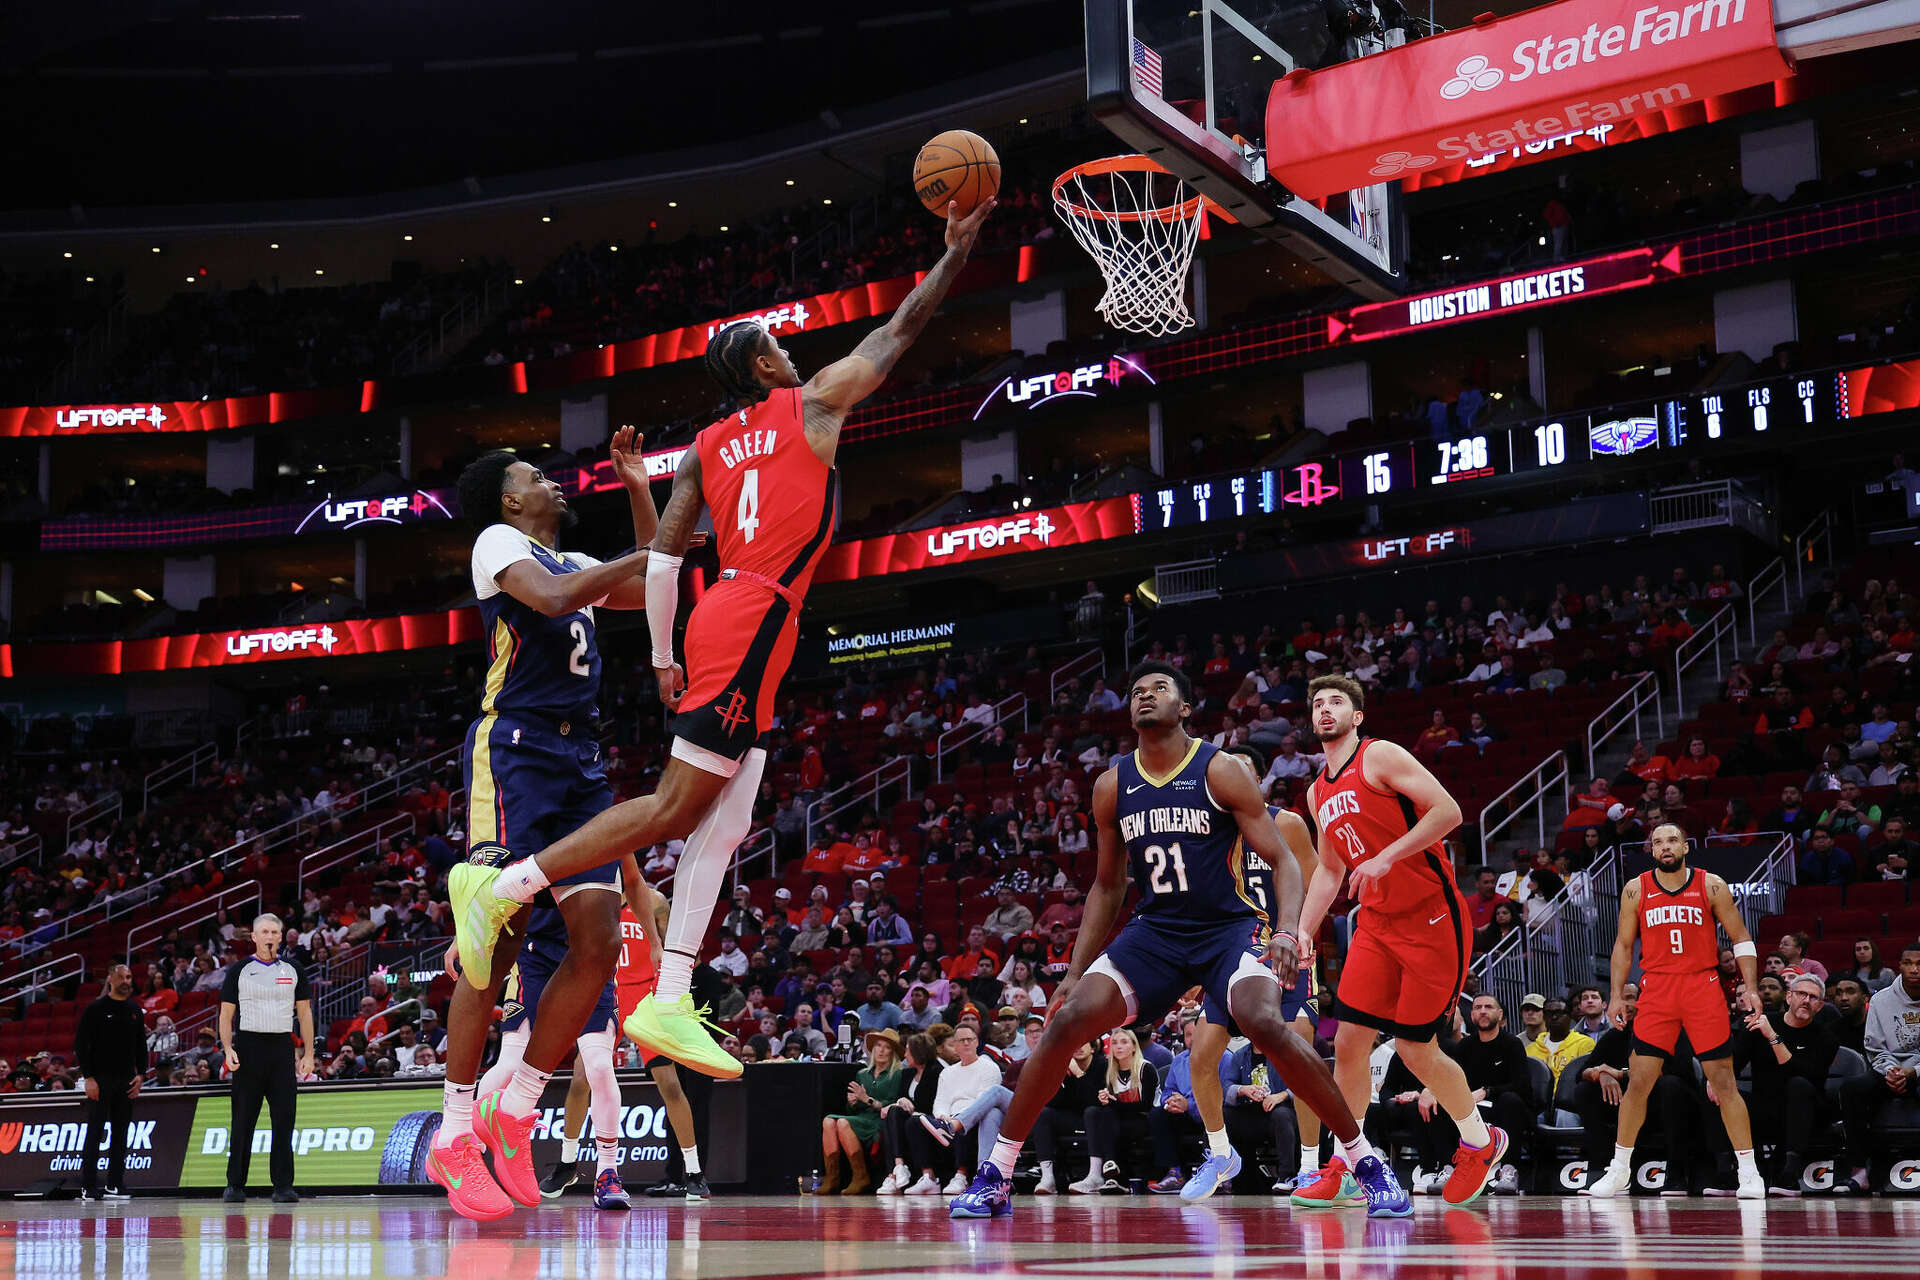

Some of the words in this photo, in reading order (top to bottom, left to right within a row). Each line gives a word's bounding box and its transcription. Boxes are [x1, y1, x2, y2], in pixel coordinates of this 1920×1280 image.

[1408, 286, 1490, 325] HOUSTON
[1500, 266, 1585, 307] ROCKETS
[1006, 364, 1102, 403] LIFTOFF
[1701, 395, 1723, 414] TOL
[1748, 387, 1770, 407] FLS
[1797, 379, 1815, 399] CC
[56, 407, 146, 428] LIFTOFF
[1753, 405, 1768, 431] 0
[1802, 397, 1813, 423] 1
[719, 429, 777, 469] GREEN
[1438, 436, 1488, 475] 7:36
[1534, 423, 1565, 467] 10
[1362, 452, 1391, 495] 15
[325, 496, 408, 522] LIFTOFF
[737, 469, 760, 545] 4
[1157, 489, 1175, 506] TOL
[1193, 483, 1211, 501] FLS
[1231, 477, 1245, 494] CC
[1161, 504, 1171, 528] 7
[1198, 498, 1207, 522] 1
[1234, 493, 1243, 516] 1
[928, 519, 1031, 557] LIFTOFF
[1363, 530, 1454, 560] LIFTOFF
[227, 629, 317, 656] LIFTOFF
[569, 620, 590, 677] 2
[828, 633, 889, 652] MEMORIAL
[891, 623, 953, 643] HERMANN
[1120, 811, 1146, 843] NEW
[1149, 806, 1211, 835] ORLEANS
[1334, 822, 1366, 860] 28
[1144, 842, 1189, 894] 21
[1645, 905, 1703, 928] ROCKETS
[1669, 929, 1684, 954] 9
[1559, 1160, 1588, 1189] G
[1637, 1160, 1667, 1189] G
[1803, 1160, 1835, 1190] G
